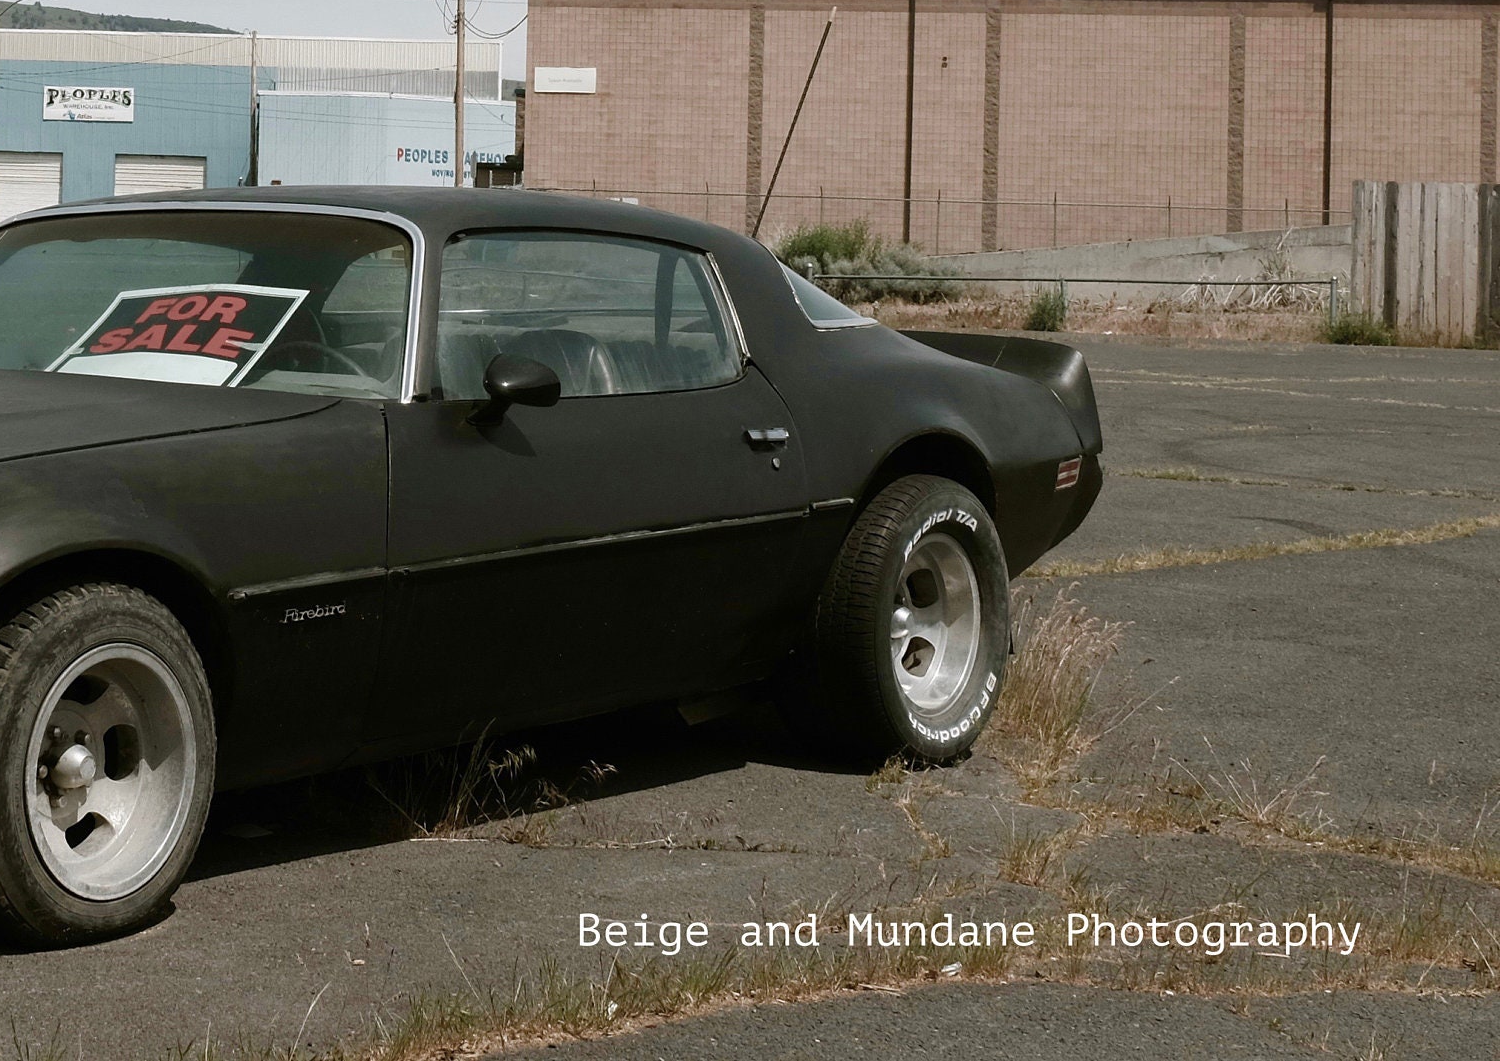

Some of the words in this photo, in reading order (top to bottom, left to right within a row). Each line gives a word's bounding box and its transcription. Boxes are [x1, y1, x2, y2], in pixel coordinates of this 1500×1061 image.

[46, 89, 132, 108] PEOPLES
[397, 148, 448, 164] PEOPLES
[432, 169, 454, 178] MOVING
[135, 295, 247, 325] FOR
[89, 323, 255, 359] SALE
[279, 600, 346, 624] Firebird
